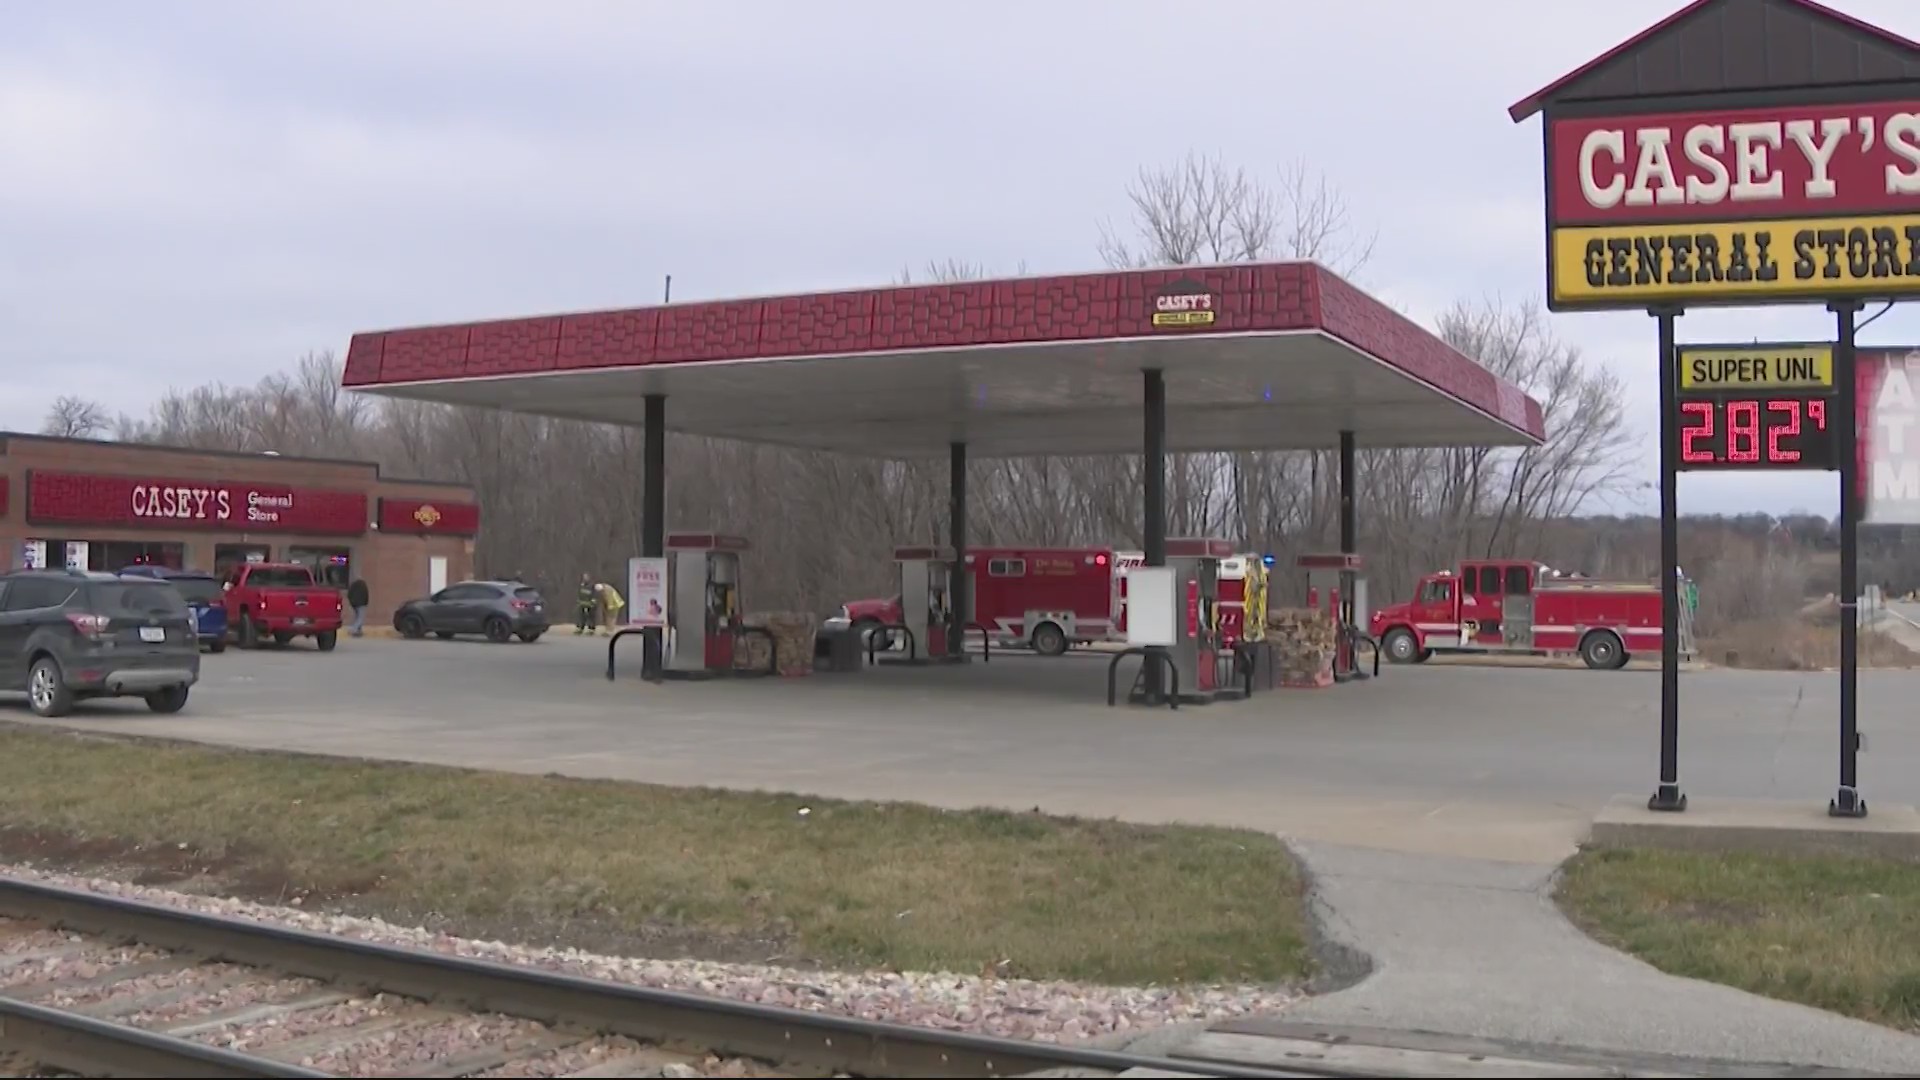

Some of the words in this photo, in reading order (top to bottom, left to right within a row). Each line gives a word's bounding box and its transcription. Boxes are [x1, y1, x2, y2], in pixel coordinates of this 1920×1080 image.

[1579, 112, 1920, 208] CASEY'S
[1584, 231, 1778, 287] GENERAL
[1156, 293, 1212, 311] CASEY'S
[1692, 358, 1768, 383] SUPER
[1776, 357, 1822, 382] UNL
[132, 485, 231, 520] CASEY'S
[247, 491, 293, 508] General
[247, 507, 279, 522] Store
